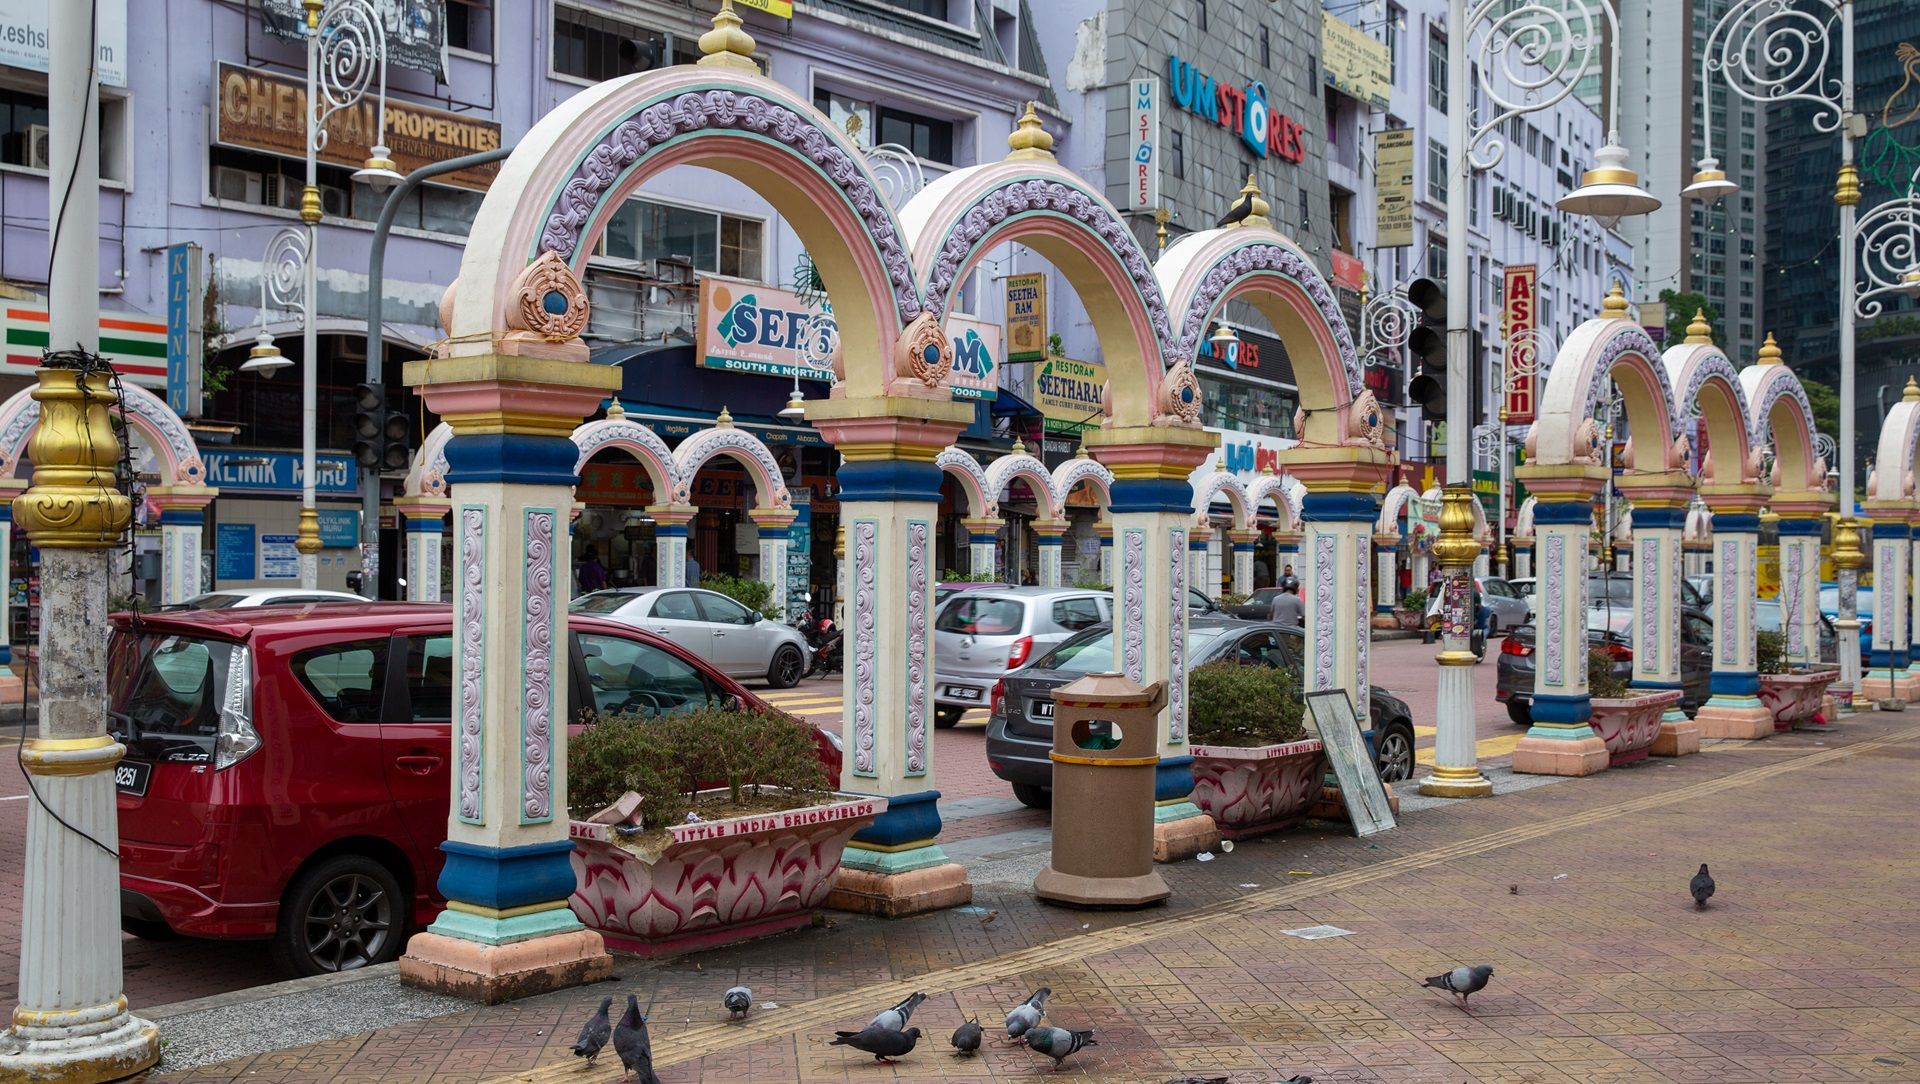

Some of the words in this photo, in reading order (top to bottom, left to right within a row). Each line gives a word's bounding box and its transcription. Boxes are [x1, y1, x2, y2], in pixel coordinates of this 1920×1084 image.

[383, 107, 499, 152] PROPERTIES
[1008, 278, 1038, 288] RESTORAN
[1008, 286, 1038, 302] SEETHA
[1015, 301, 1033, 314] RAM
[172, 253, 184, 410] KLINIK
[725, 359, 767, 372] SOUTH
[770, 364, 779, 374] &
[783, 366, 821, 379] NORTH
[1055, 360, 1095, 377] RESTORAN
[168, 753, 209, 761] ALZA
[1266, 748, 1289, 758] LITTLE
[115, 766, 137, 787] 8251
[671, 825, 725, 843] LITTLE
[733, 819, 776, 834] INDIA
[784, 804, 873, 827] BRICKFIELDS
[570, 825, 595, 839] BKL
